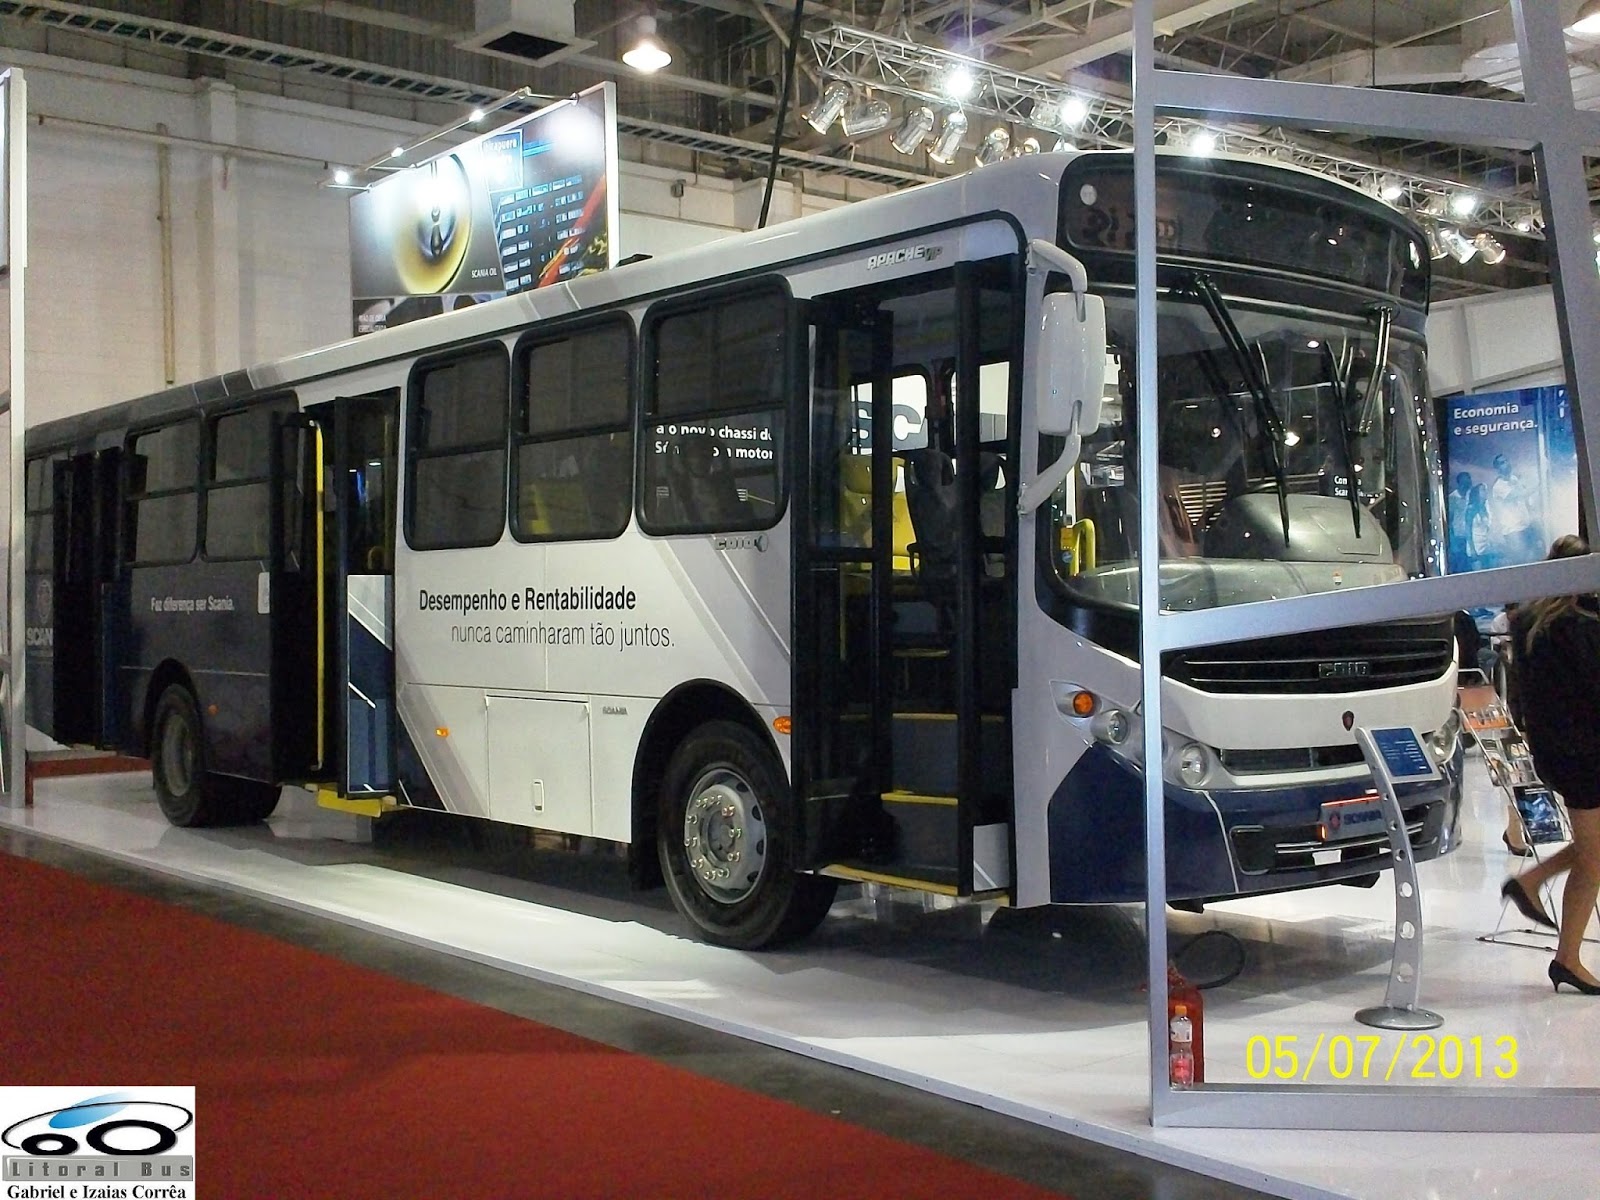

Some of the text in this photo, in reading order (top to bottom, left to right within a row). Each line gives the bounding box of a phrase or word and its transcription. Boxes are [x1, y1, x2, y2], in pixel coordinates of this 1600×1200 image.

[867, 245, 925, 270] APACHE
[471, 267, 498, 278] SCANIA OIL
[1453, 402, 1520, 420] Economia
[719, 425, 757, 440] chassi
[1453, 417, 1538, 437] e segurança.
[419, 585, 636, 616] Desempenho e Rentabilidade
[451, 621, 675, 652] nunca caminharam tão juntos.
